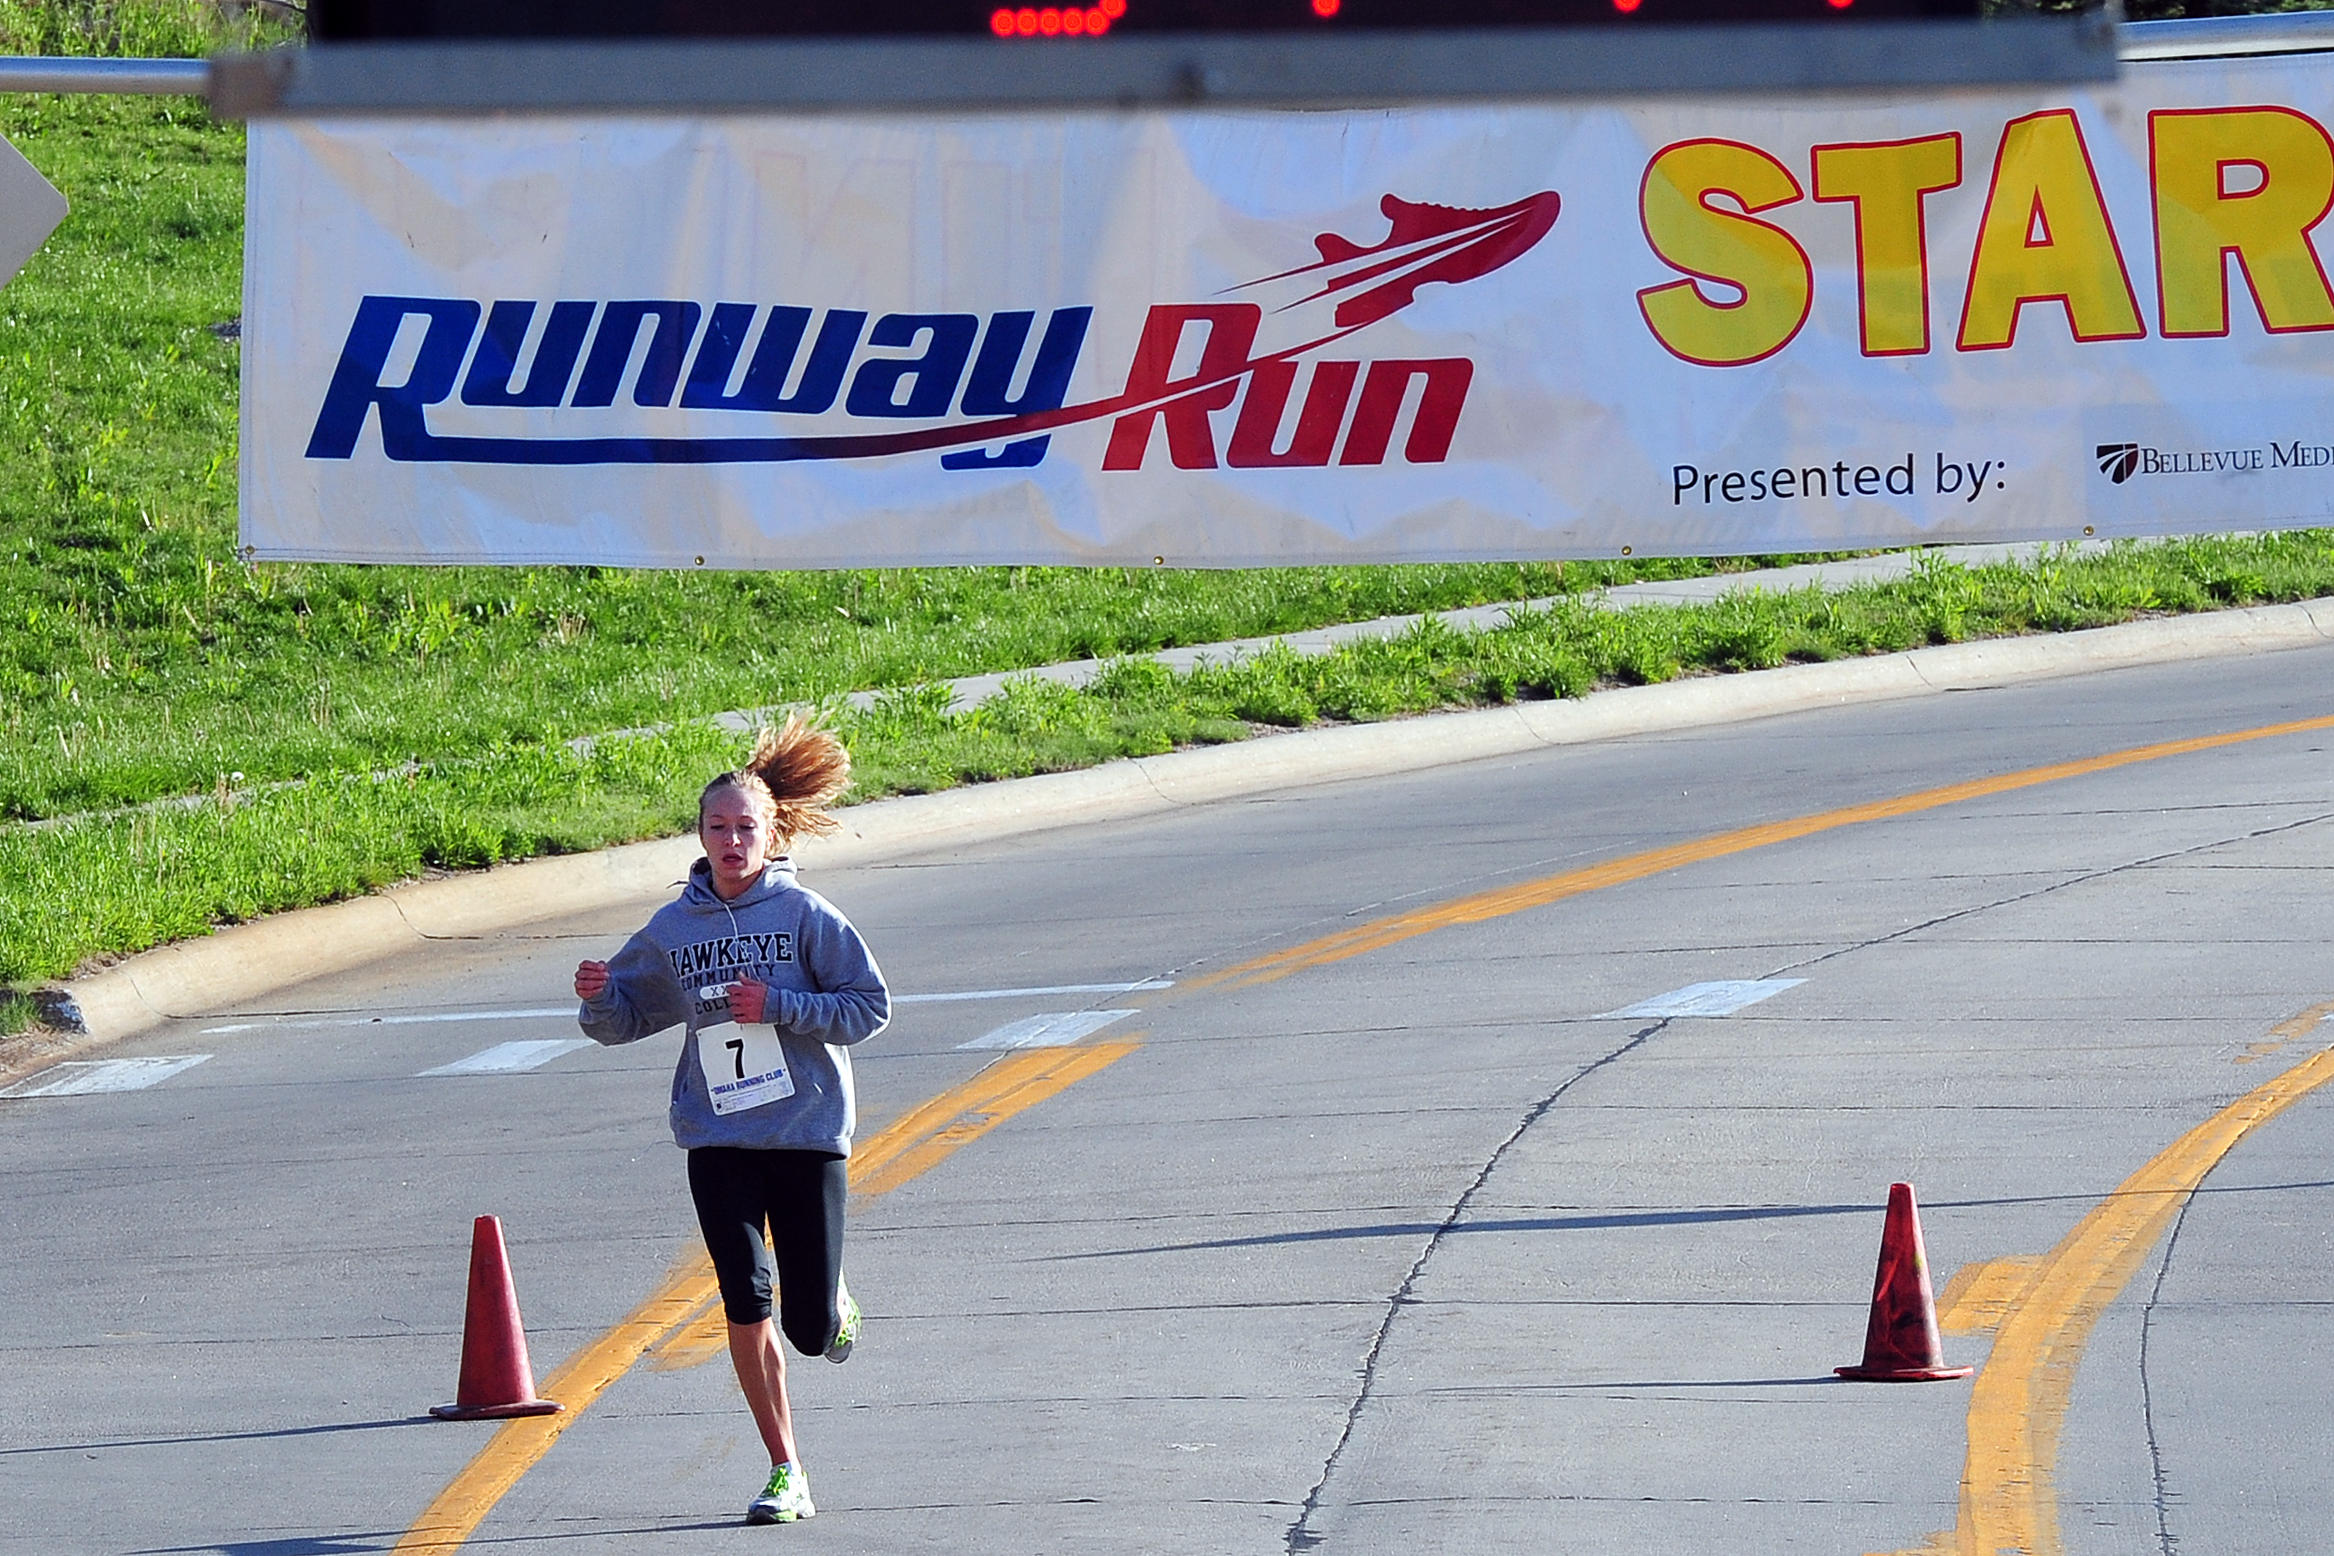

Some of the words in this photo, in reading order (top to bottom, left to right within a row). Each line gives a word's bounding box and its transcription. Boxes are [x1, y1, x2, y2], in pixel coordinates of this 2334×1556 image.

[1636, 106, 2334, 367] STAR
[304, 295, 1094, 470] Runway
[1101, 302, 1473, 471] Run
[1672, 453, 1914, 505] Presented
[1936, 452, 2005, 502] by:
[2141, 447, 2264, 474] BELLEVUE
[695, 998, 731, 1015] COLL
[725, 1039, 745, 1079] 7
[736, 1075, 765, 1090] RUNNING
[765, 1069, 784, 1081] CLUB
